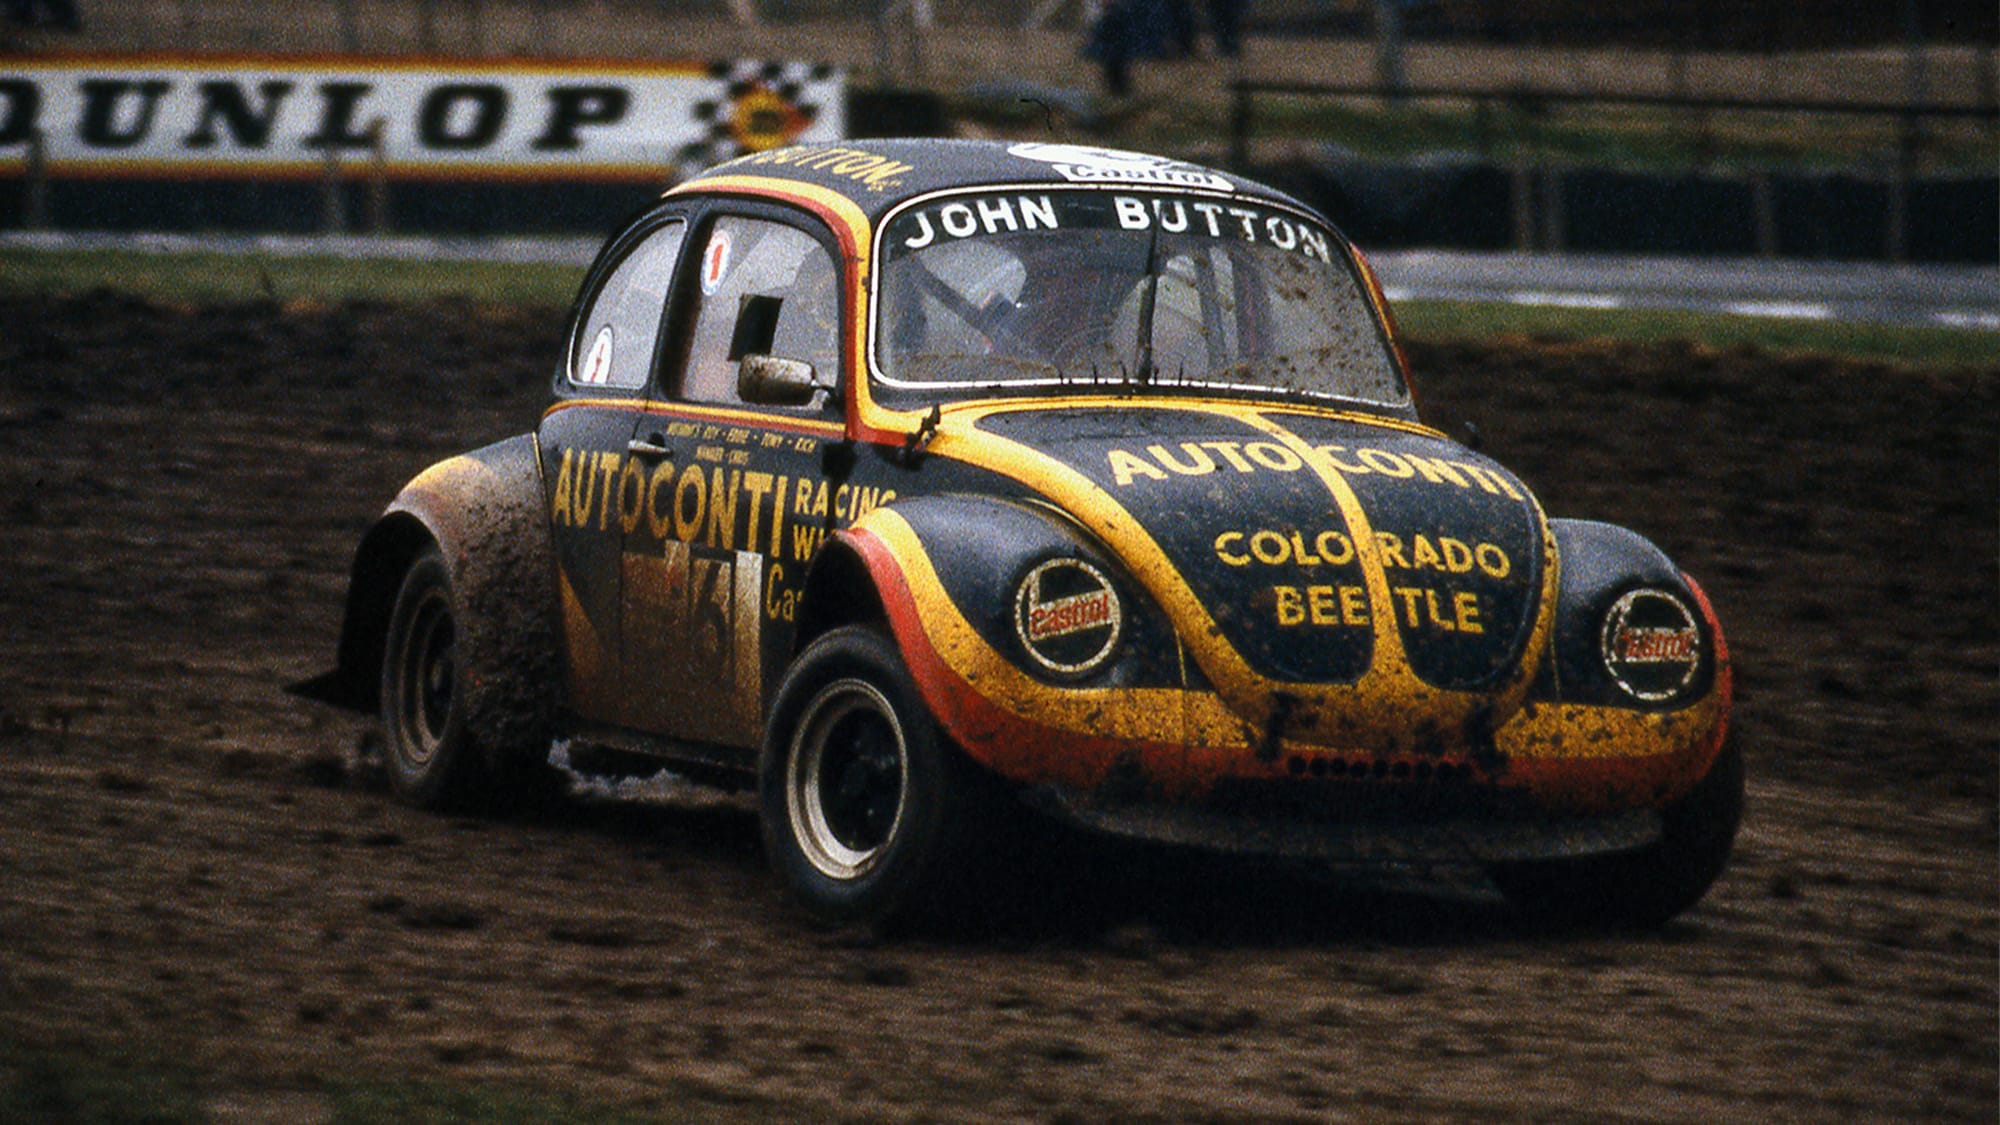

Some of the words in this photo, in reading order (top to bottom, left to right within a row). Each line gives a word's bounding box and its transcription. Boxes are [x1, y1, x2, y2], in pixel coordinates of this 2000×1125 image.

[1069, 165, 1214, 185] Castrol
[905, 196, 1058, 249] JOHN
[1113, 196, 1331, 265] BUTTON
[553, 448, 788, 558] AUTOCONTI
[1214, 530, 1511, 579] COLORADO
[1031, 593, 1109, 636] Castrol
[1273, 585, 1484, 635] BEETLE
